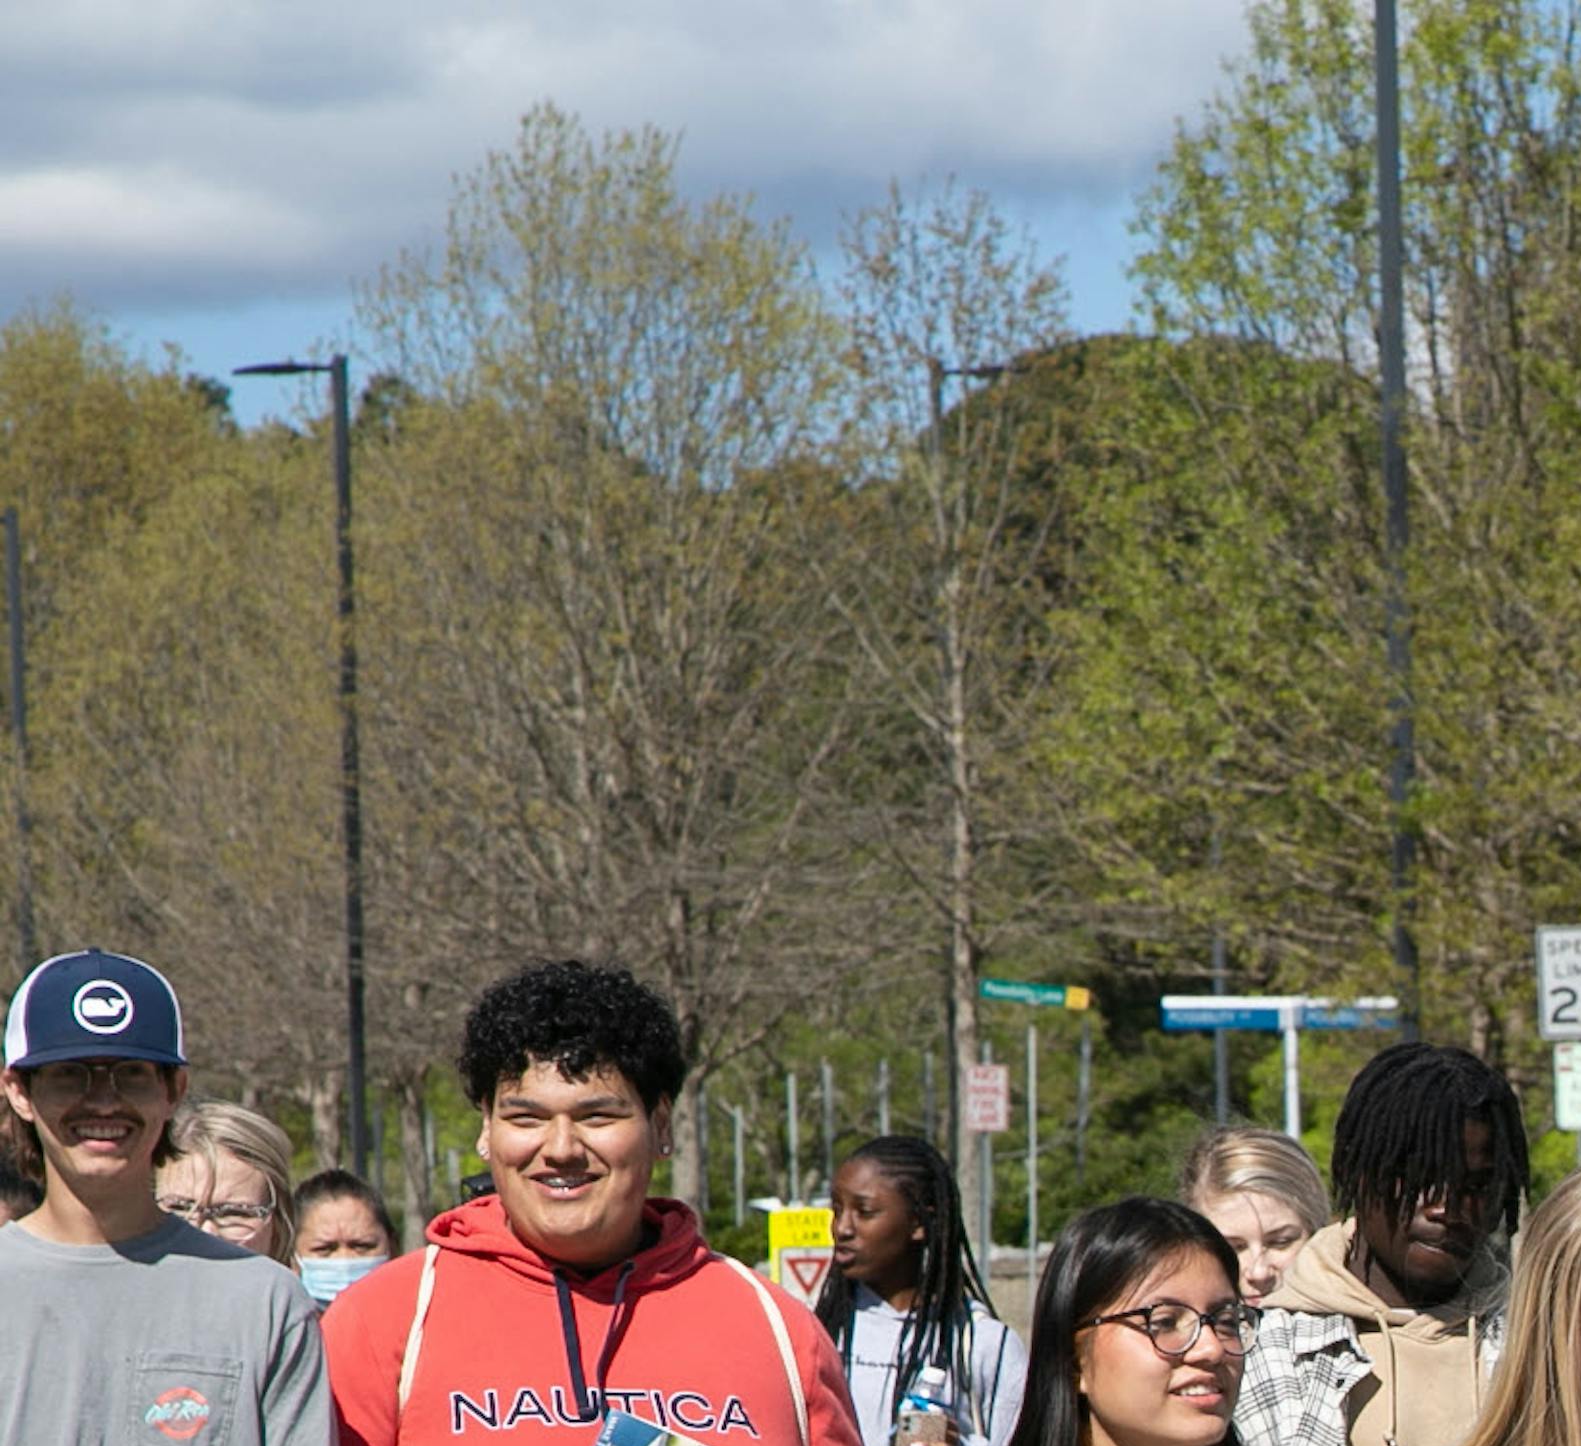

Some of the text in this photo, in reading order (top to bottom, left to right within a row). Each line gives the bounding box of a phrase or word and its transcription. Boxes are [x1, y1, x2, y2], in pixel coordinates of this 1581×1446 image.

[786, 1213, 826, 1226] STATE
[792, 1231, 821, 1241] LAW
[450, 1386, 761, 1441] NAUTICA
